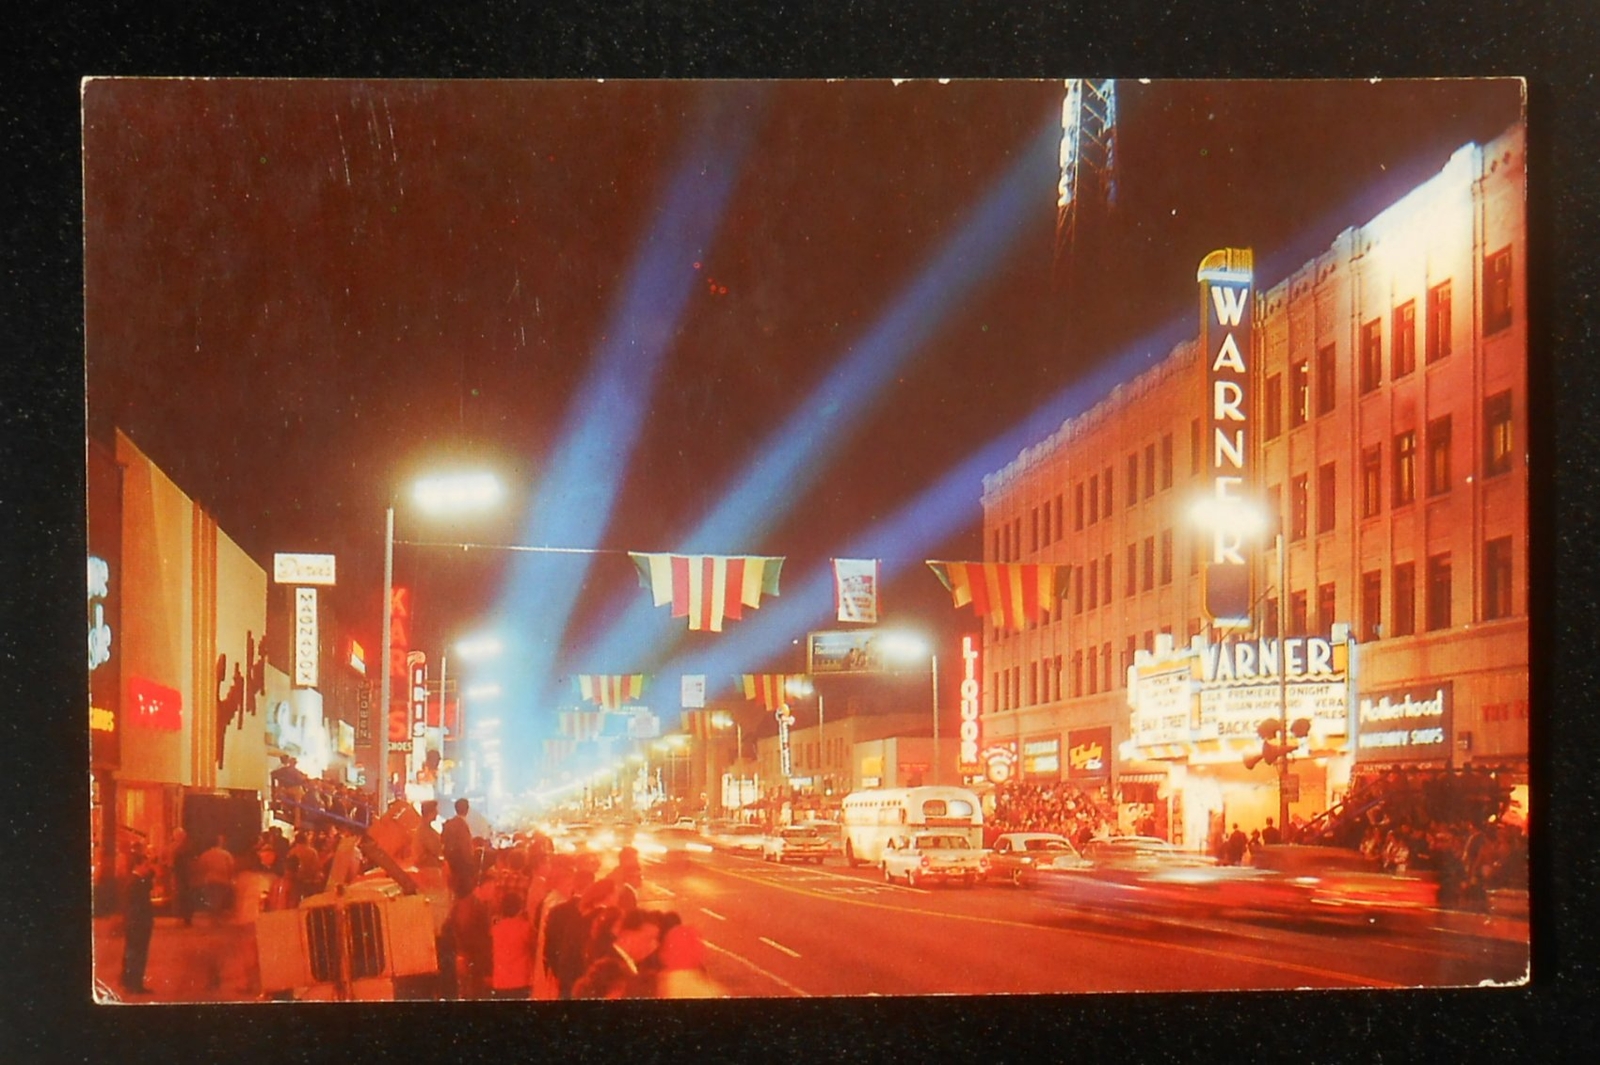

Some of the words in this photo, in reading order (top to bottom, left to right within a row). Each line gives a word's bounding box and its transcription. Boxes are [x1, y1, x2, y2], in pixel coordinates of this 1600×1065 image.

[1210, 286, 1249, 565] WARNER
[299, 594, 314, 681] MAGNAVOX
[1200, 637, 1334, 682] WARNER
[413, 668, 426, 736] IRIS
[960, 636, 979, 763] LIQUOR
[1288, 685, 1330, 697] ONIGHT
[1359, 689, 1444, 725] Motherhood
